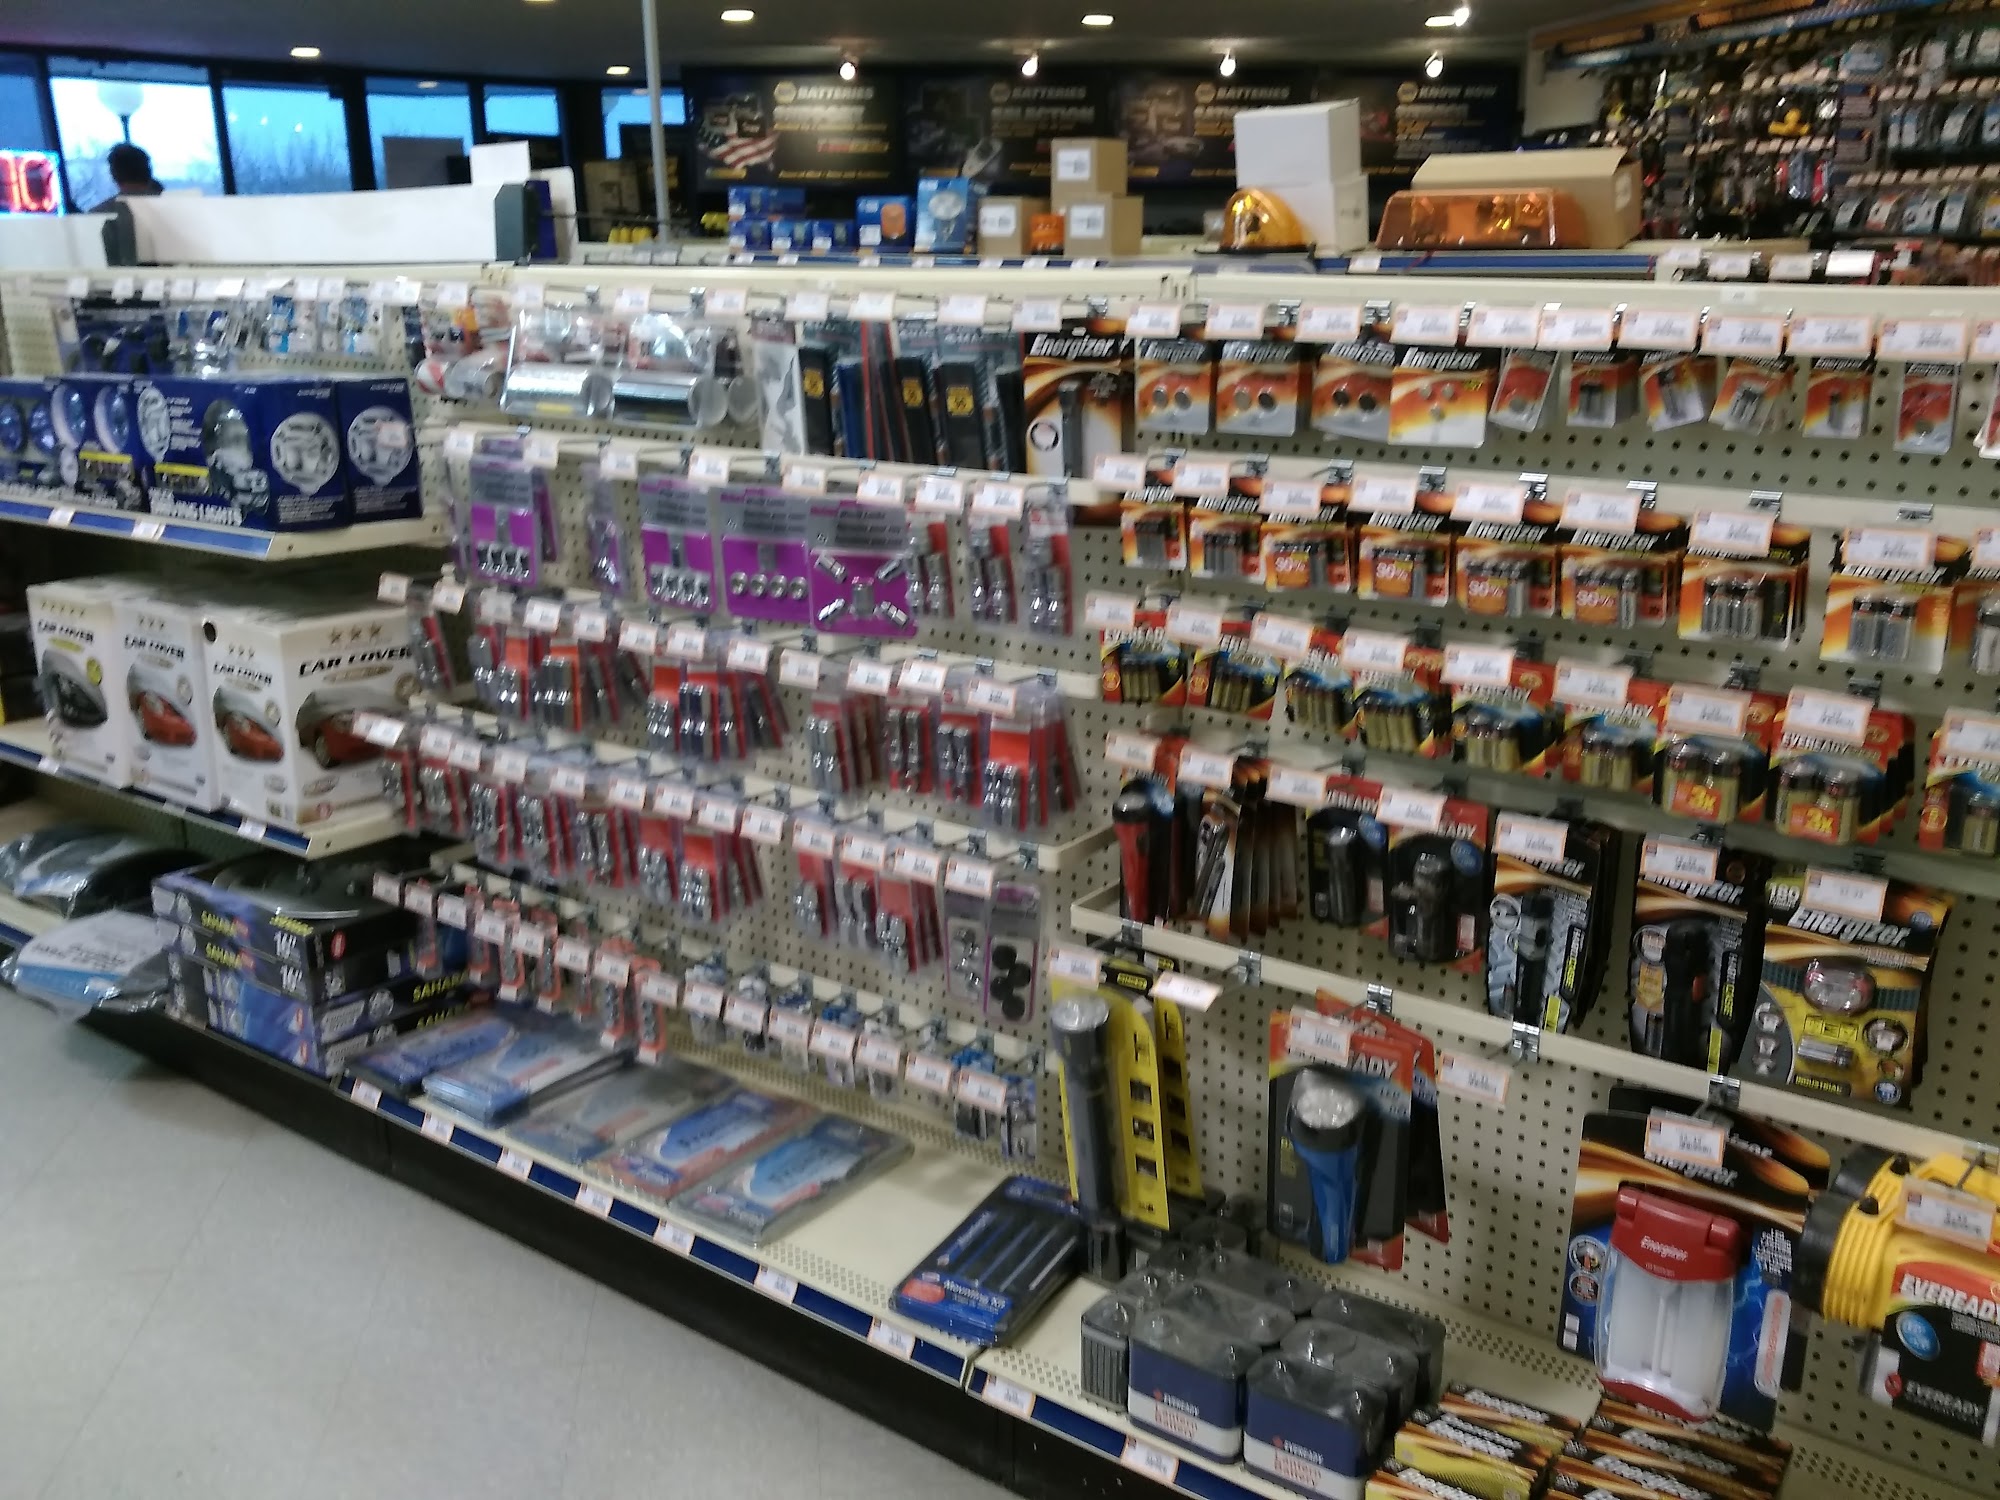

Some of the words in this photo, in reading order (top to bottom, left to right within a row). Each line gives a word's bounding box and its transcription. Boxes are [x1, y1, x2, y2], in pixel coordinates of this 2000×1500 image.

[797, 86, 874, 100] BATTERIES
[1011, 86, 1087, 100] BATTERIES
[1216, 86, 1290, 100] BATTERIES
[1030, 333, 1114, 361] Energizer
[1401, 346, 1482, 372] Energizer
[299, 657, 342, 677] CAR
[1788, 905, 1911, 948] Energizer
[1640, 1235, 1688, 1262] Energizer
[1900, 1272, 2000, 1326] EVEREAD
